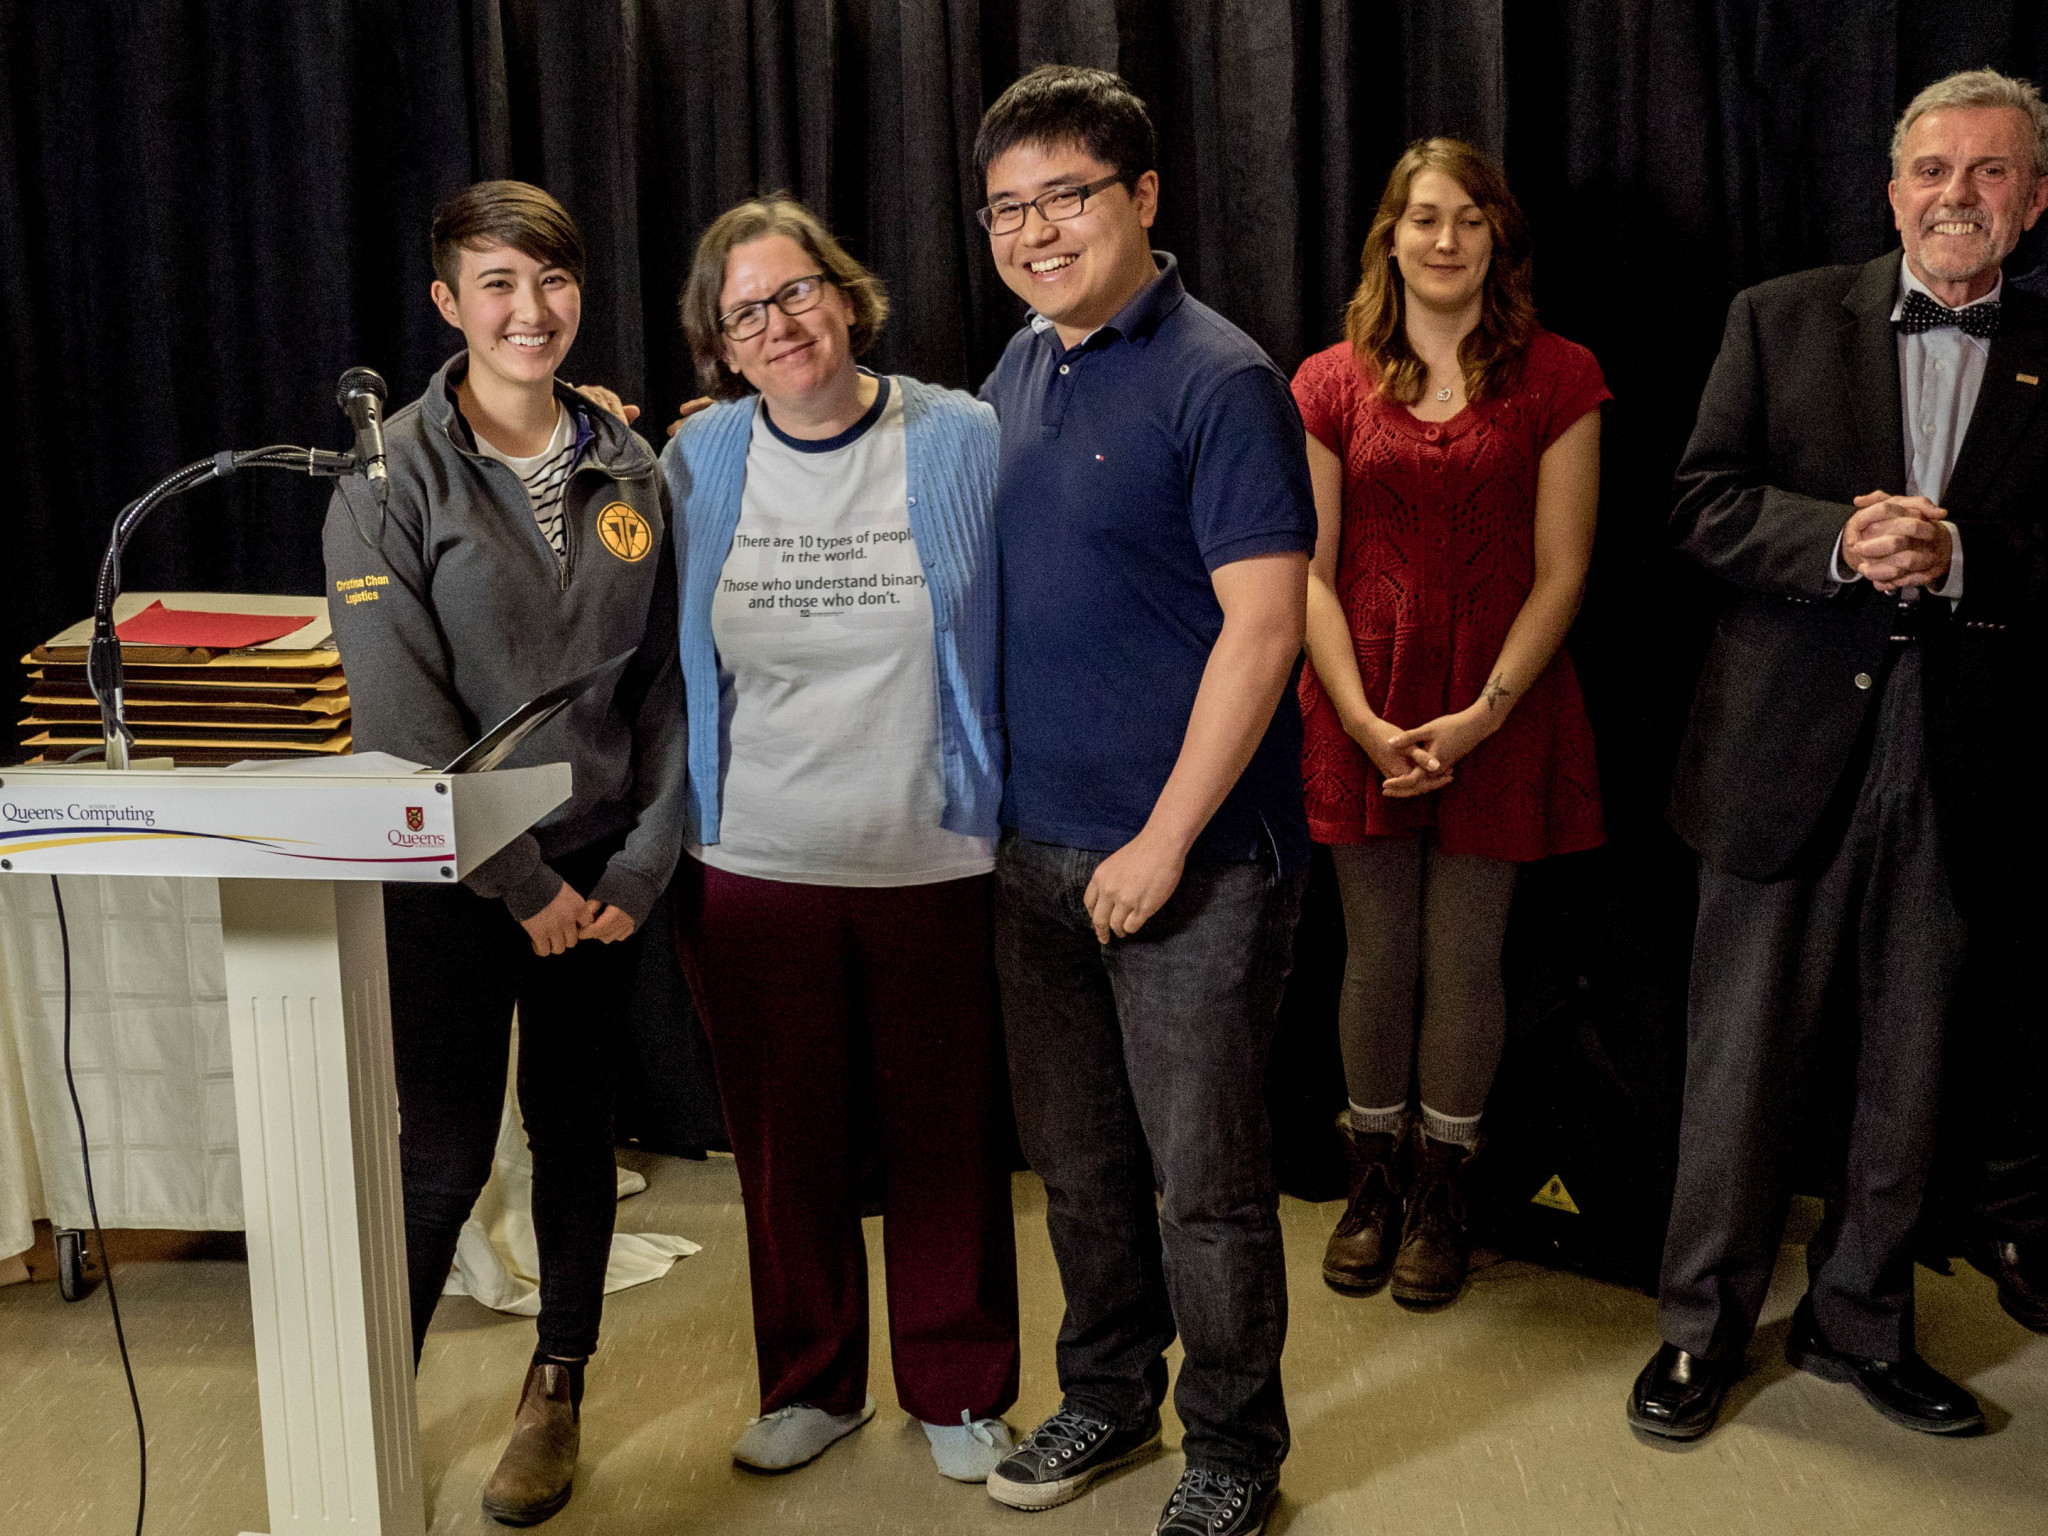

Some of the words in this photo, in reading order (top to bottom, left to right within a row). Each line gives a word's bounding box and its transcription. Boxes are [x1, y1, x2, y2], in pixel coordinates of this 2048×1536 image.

[736, 534, 771, 549] There
[773, 537, 795, 549] are
[799, 535, 814, 549] 10
[816, 536, 853, 550] types
[856, 530, 870, 544] of
[873, 527, 914, 545] peopl
[781, 551, 795, 563] in
[798, 551, 821, 563] the
[824, 547, 867, 562] world.
[365, 574, 390, 587] Chan
[723, 578, 759, 593] Those
[762, 577, 792, 591] who
[795, 573, 877, 590] understand
[881, 573, 926, 589] binary
[748, 595, 775, 609] and
[778, 594, 818, 608] those
[822, 592, 854, 607] who
[858, 590, 900, 606] don't.
[2, 802, 64, 824] Queen's
[67, 803, 156, 826] Computing
[387, 829, 446, 848] Queen's
